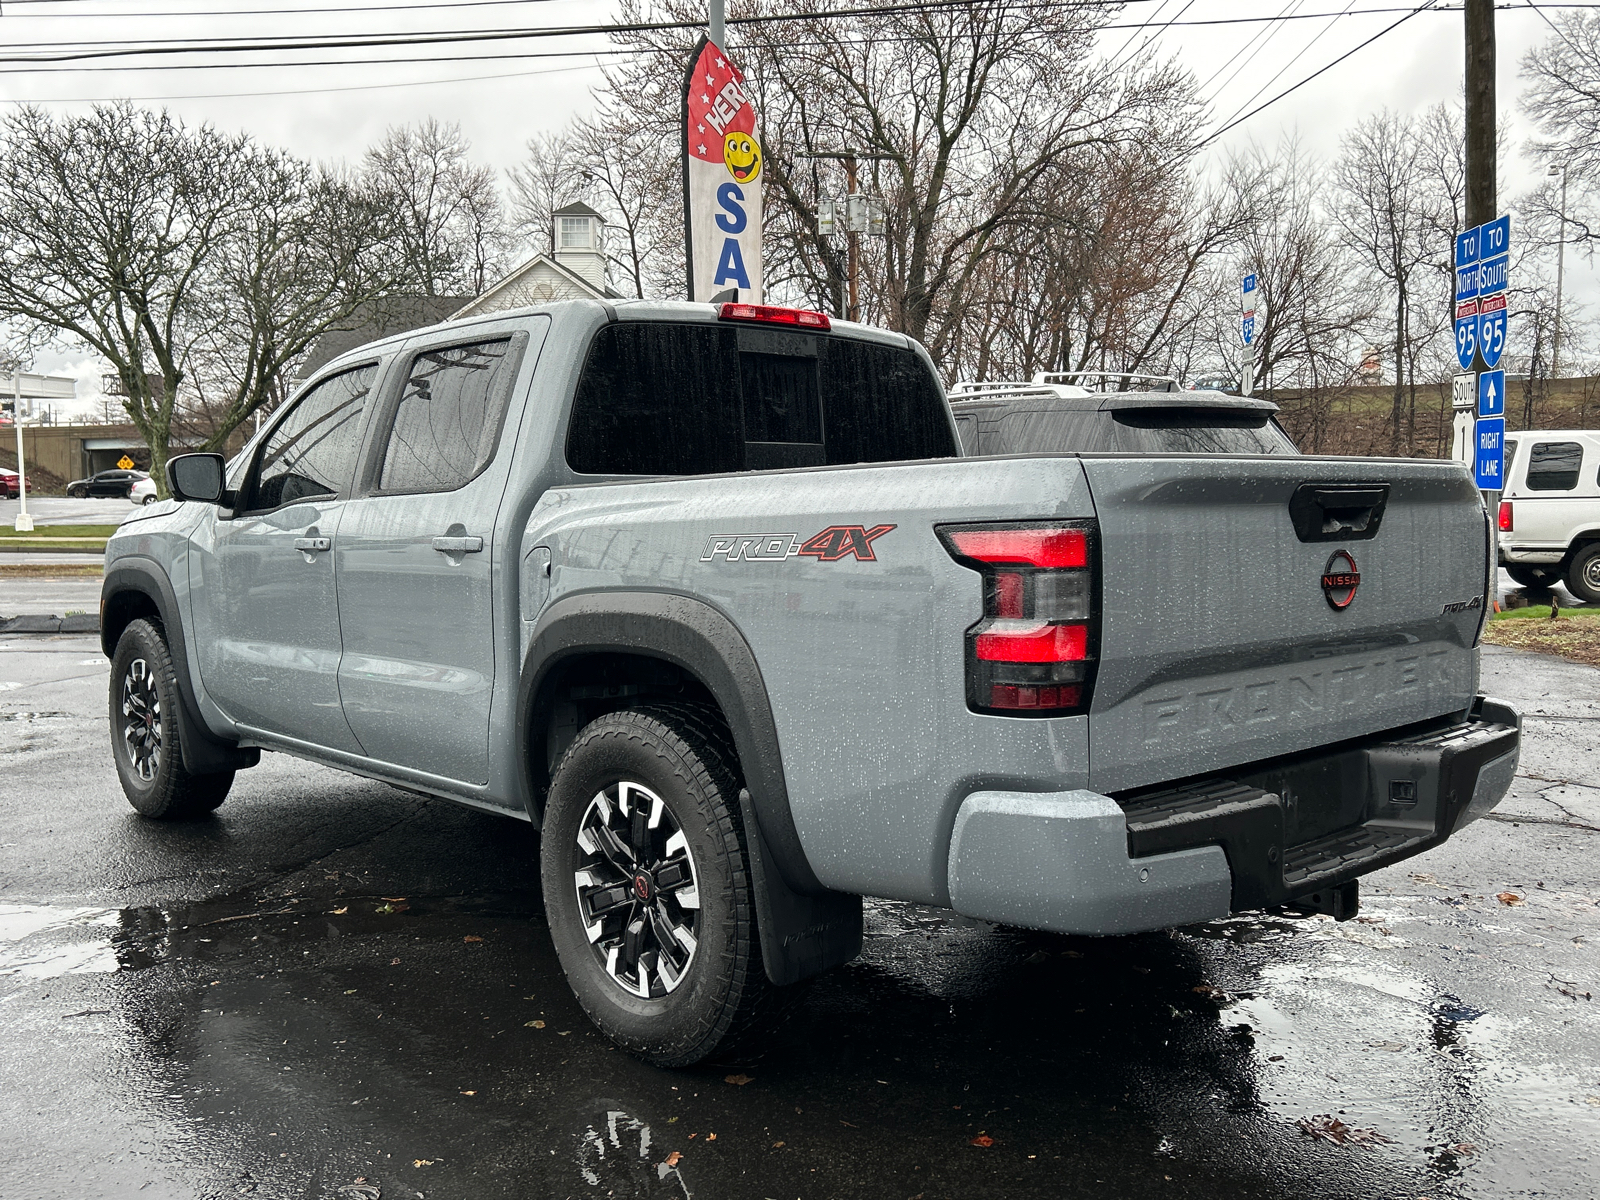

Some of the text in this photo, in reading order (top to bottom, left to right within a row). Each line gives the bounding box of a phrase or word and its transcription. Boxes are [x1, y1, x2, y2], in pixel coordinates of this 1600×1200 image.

[704, 76, 748, 137] HER
[1463, 236, 1475, 258] TO
[1489, 226, 1503, 250] TO
[1246, 278, 1253, 290] TO
[1457, 270, 1479, 294] NORTH
[1481, 261, 1508, 289] SOUTH
[1244, 321, 1252, 338] 95
[1458, 323, 1475, 357] 95
[1483, 318, 1503, 354] 95
[1454, 380, 1475, 401] SOUTH
[1461, 425, 1466, 461] 1
[1481, 432, 1500, 449] RIGHT
[1481, 460, 1499, 476] LANE
[1323, 575, 1360, 586] NISSAN
